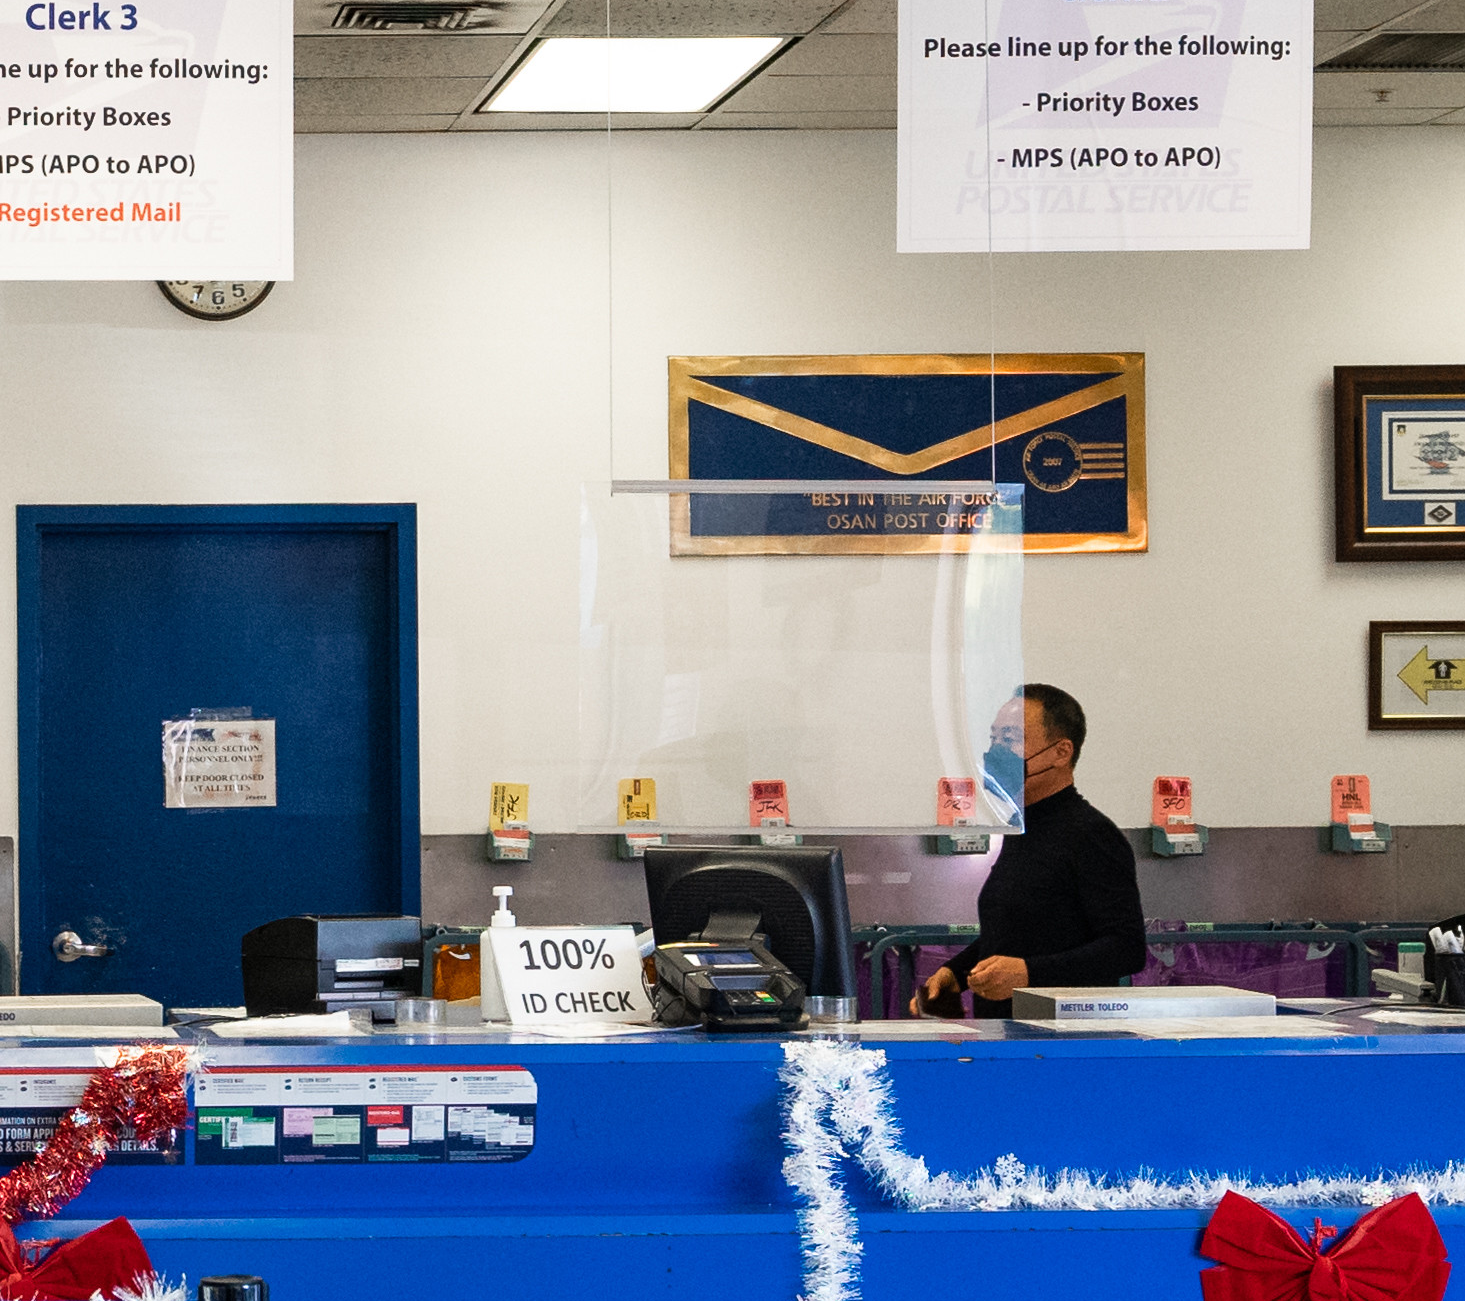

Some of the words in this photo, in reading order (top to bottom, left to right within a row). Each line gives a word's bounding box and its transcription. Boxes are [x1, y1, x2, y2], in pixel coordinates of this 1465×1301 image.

[25, 2, 112, 31] Clerk
[120, 3, 138, 31] 3
[924, 37, 1002, 58] Please
[1007, 36, 1052, 57] line
[1058, 41, 1089, 62] up
[1094, 35, 1129, 57] for
[1133, 35, 1173, 56] the
[1178, 34, 1291, 61] following:
[28, 63, 59, 84] up
[64, 57, 99, 79] for
[104, 57, 144, 79] the
[149, 57, 268, 85] following:
[1037, 91, 1126, 117] Priority
[1132, 91, 1199, 112] Boxes
[7, 106, 96, 132] Priority
[102, 106, 172, 127] Boxes
[41, 154, 100, 177] (APO
[105, 156, 131, 175] to
[136, 154, 196, 177] APO)
[1011, 147, 1064, 168] MPS
[1070, 147, 1129, 171] (APO
[1133, 149, 1159, 168] to
[1164, 146, 1221, 170] APO)
[131, 201, 181, 222] Mail
[858, 493, 874, 506] IN
[884, 493, 911, 506] THE
[919, 493, 947, 505] AIR
[828, 514, 876, 529] OSAN
[884, 513, 929, 528] POST
[936, 513, 992, 528] OFFICE
[1342, 793, 1361, 801] HNL
[519, 938, 615, 971] 100%
[521, 993, 548, 1014] ID
[554, 990, 637, 1014] CHECK
[1060, 1003, 1094, 1011] METTLER
[1098, 1003, 1128, 1011] TOLEDO
